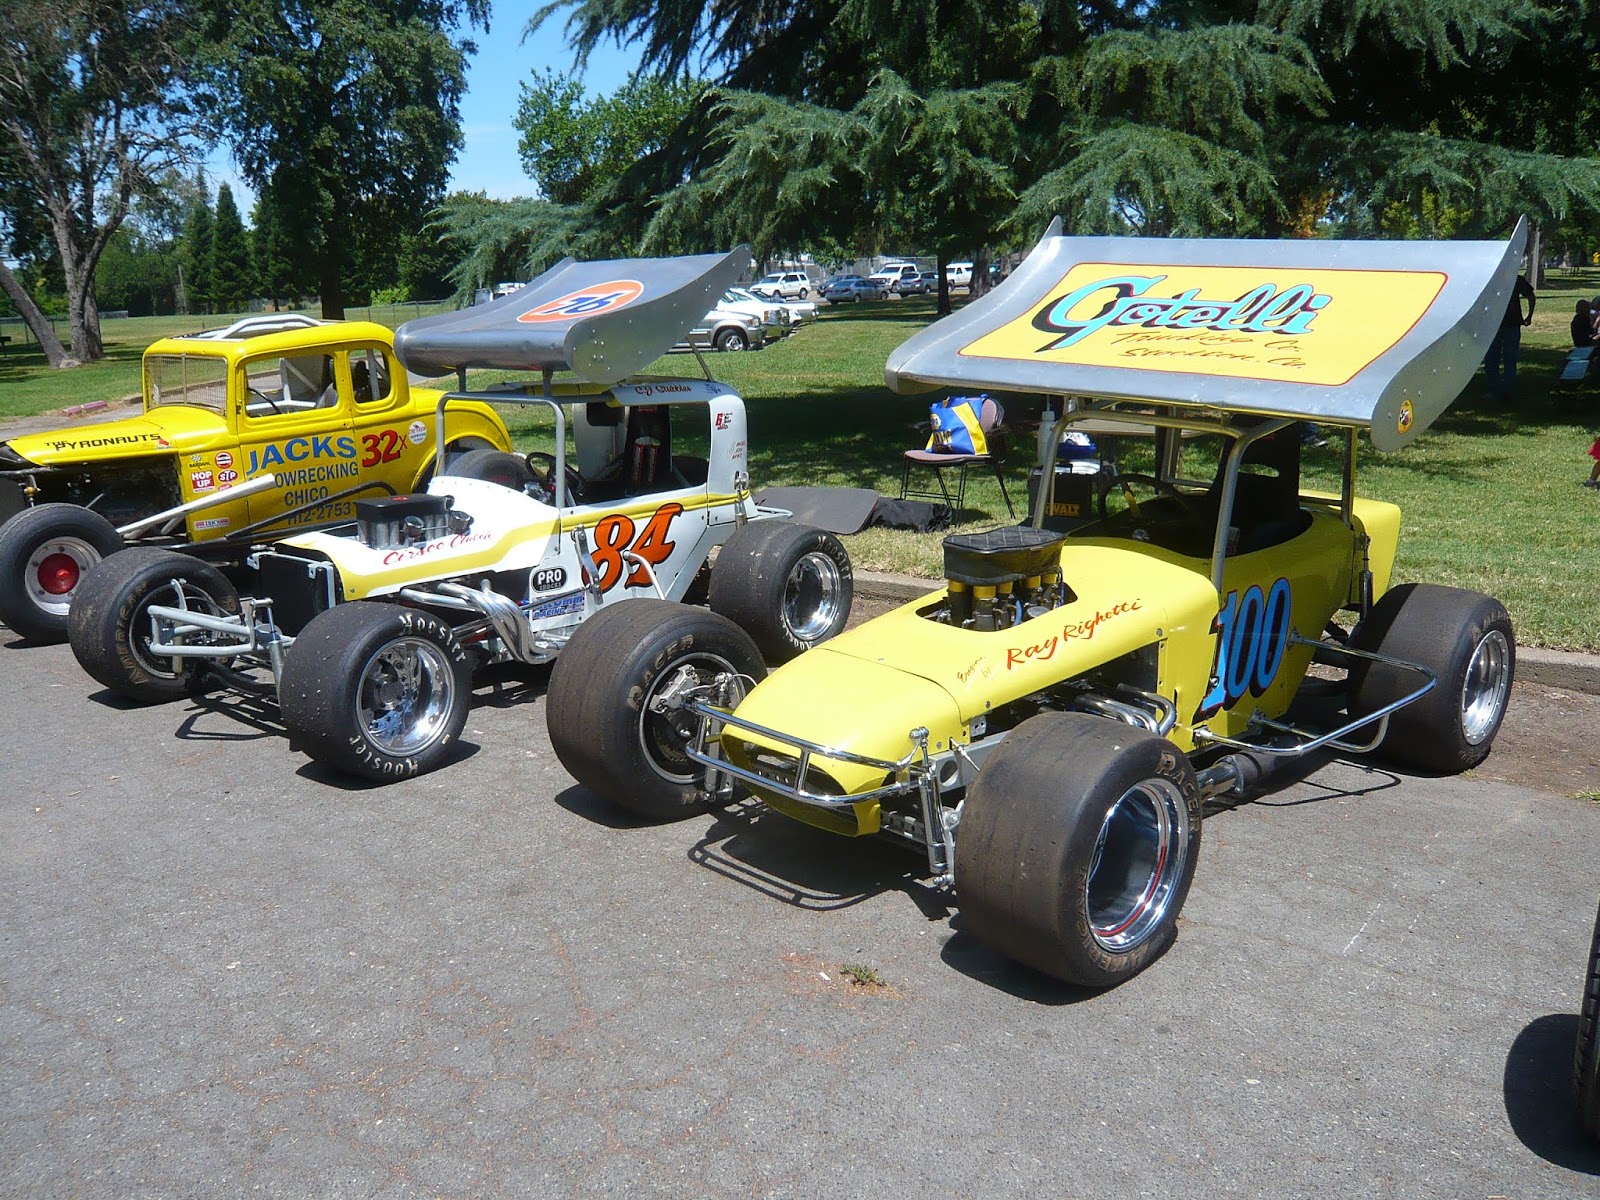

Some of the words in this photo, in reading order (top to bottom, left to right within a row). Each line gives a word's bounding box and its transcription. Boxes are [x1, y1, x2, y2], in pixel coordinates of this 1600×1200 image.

[1031, 275, 1332, 353] Gotelli
[1110, 331, 1253, 346] Trucking
[55, 433, 160, 451] PYRONAUTS
[246, 436, 357, 476] JACKS
[191, 471, 212, 480] HOP
[219, 470, 236, 481] STP
[249, 462, 359, 488] OWRECKING
[284, 486, 329, 506] CHICO
[581, 502, 685, 594] 84
[537, 569, 562, 585] PRO
[1006, 636, 1058, 670] Ray
[1063, 599, 1142, 642] Righetti
[1198, 577, 1292, 714] 100
